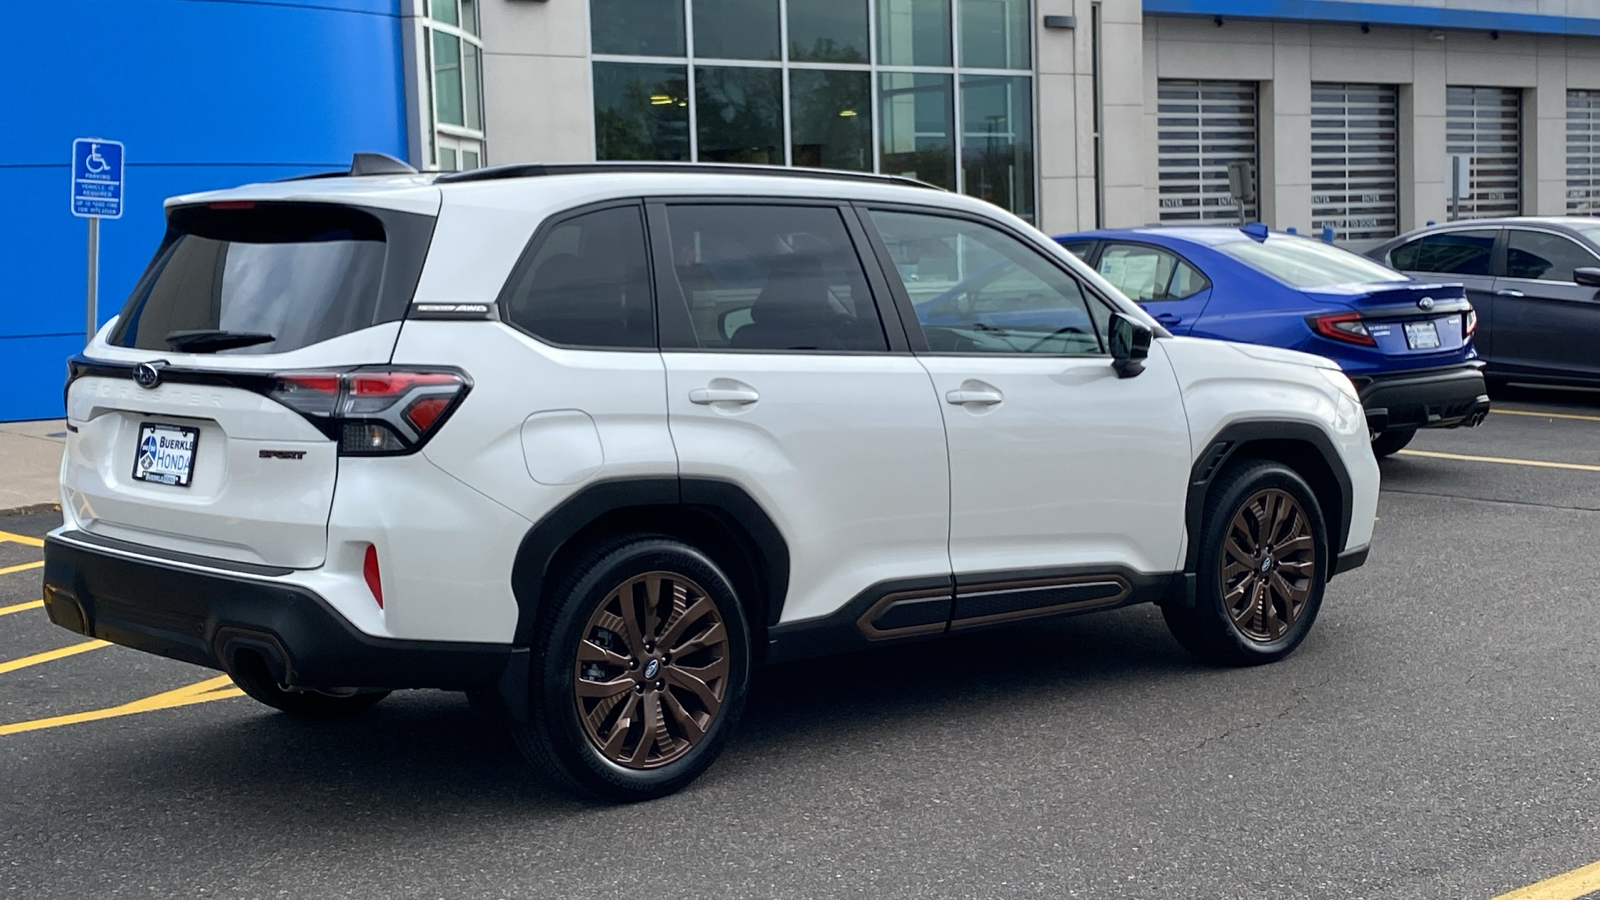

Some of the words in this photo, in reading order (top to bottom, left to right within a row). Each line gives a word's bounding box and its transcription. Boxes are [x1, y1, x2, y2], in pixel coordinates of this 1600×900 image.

[454, 304, 487, 312] AWD
[87, 383, 223, 407] FORESTER
[159, 436, 193, 451] BUERKLE
[156, 449, 190, 471] HONDA
[258, 449, 307, 460] SPORT
